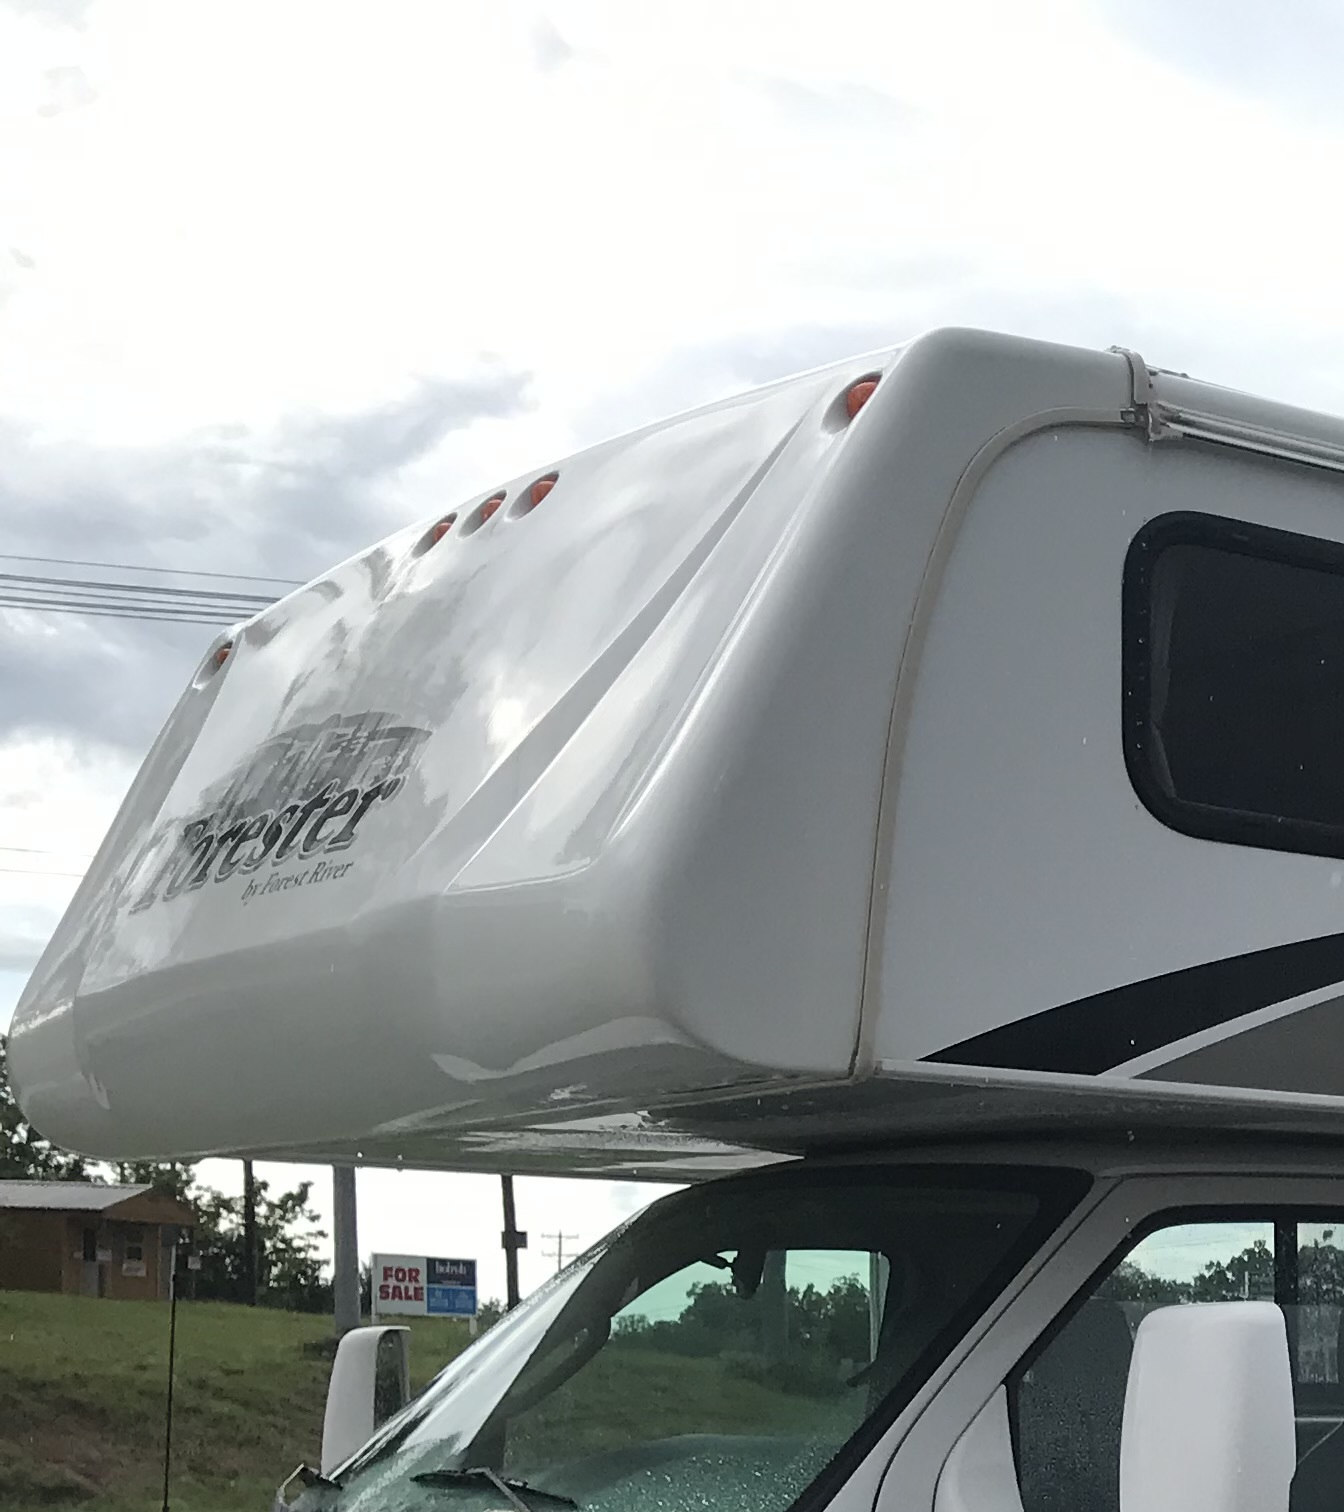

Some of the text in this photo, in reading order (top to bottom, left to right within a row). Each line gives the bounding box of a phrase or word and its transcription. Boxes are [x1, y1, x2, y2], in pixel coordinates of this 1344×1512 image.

[259, 872, 309, 896] Forest
[307, 860, 354, 885] River
[382, 1266, 421, 1283] FOR
[379, 1285, 424, 1302] SALE
